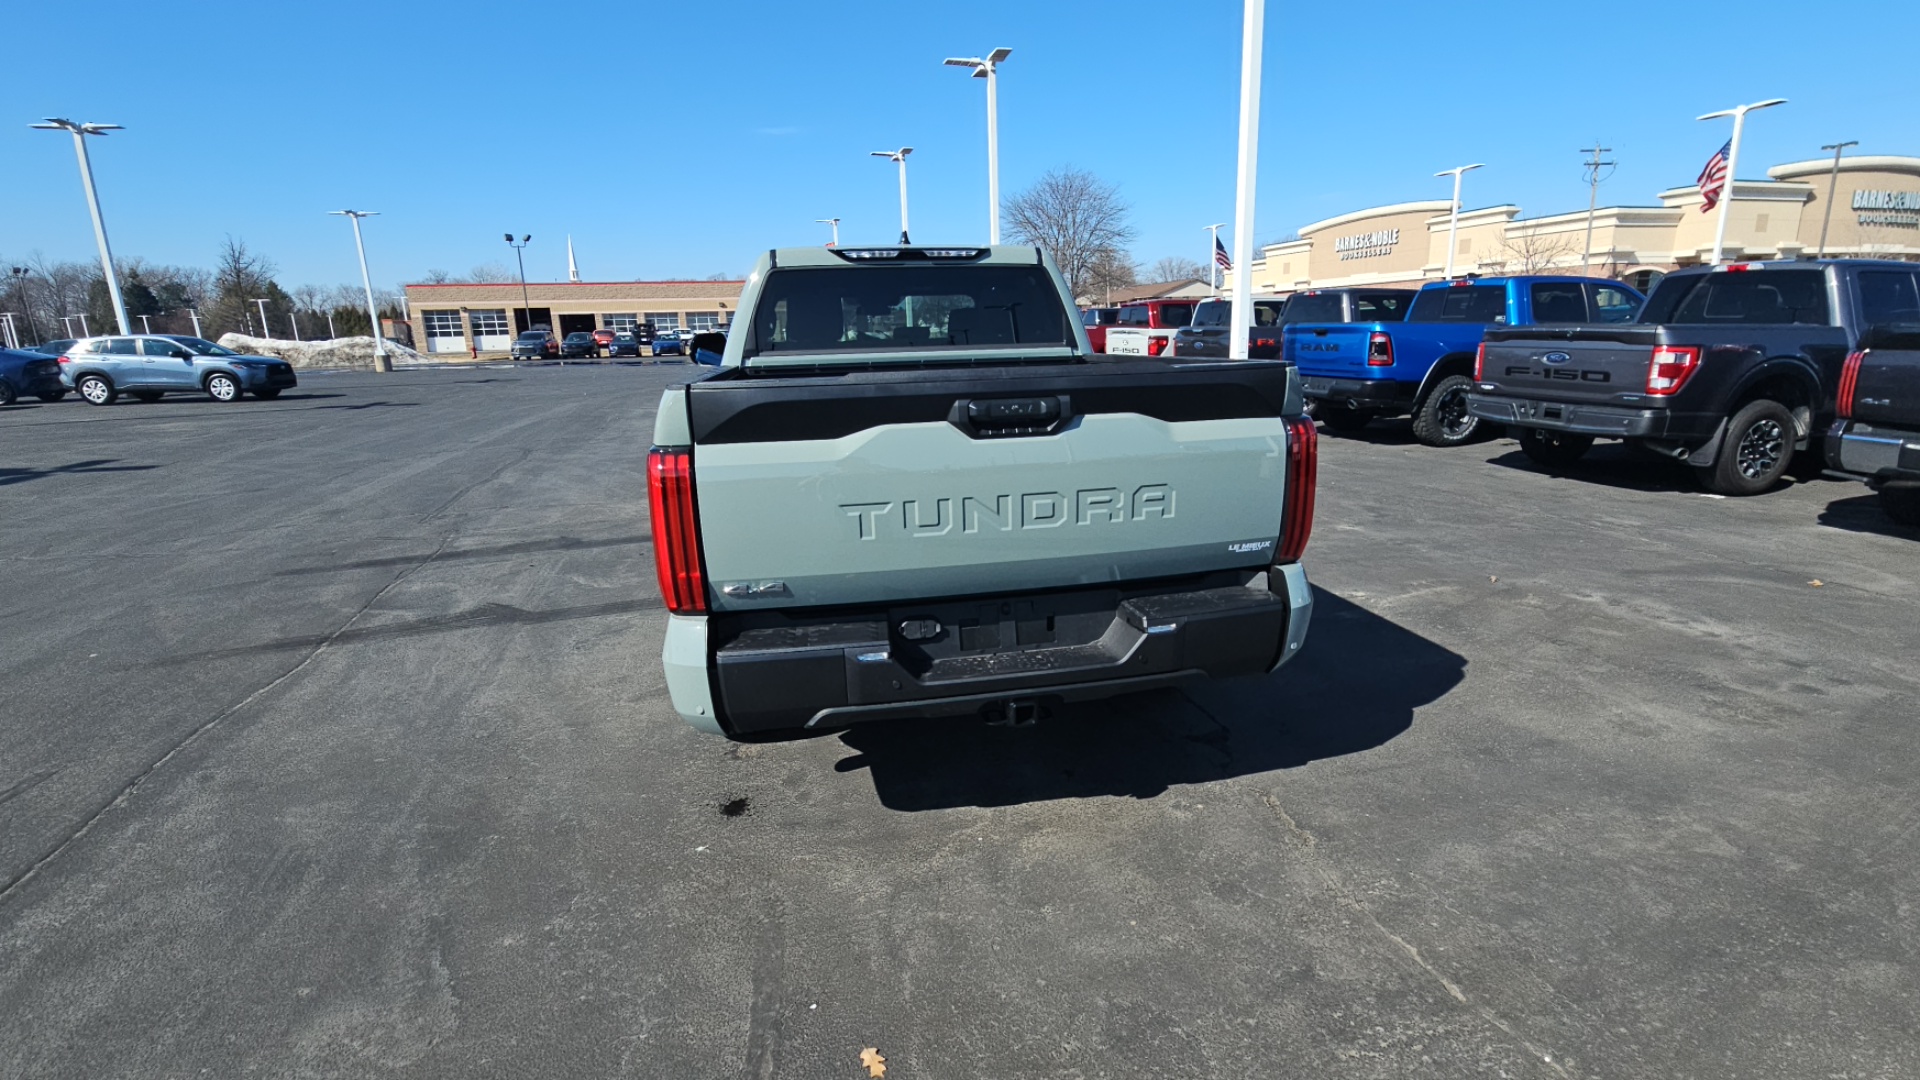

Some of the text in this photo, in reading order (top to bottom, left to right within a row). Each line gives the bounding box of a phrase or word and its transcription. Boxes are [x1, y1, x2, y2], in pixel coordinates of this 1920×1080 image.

[1301, 343, 1340, 352] RAM
[1505, 366, 1611, 383] F-150
[838, 483, 1176, 540] TUNDRA
